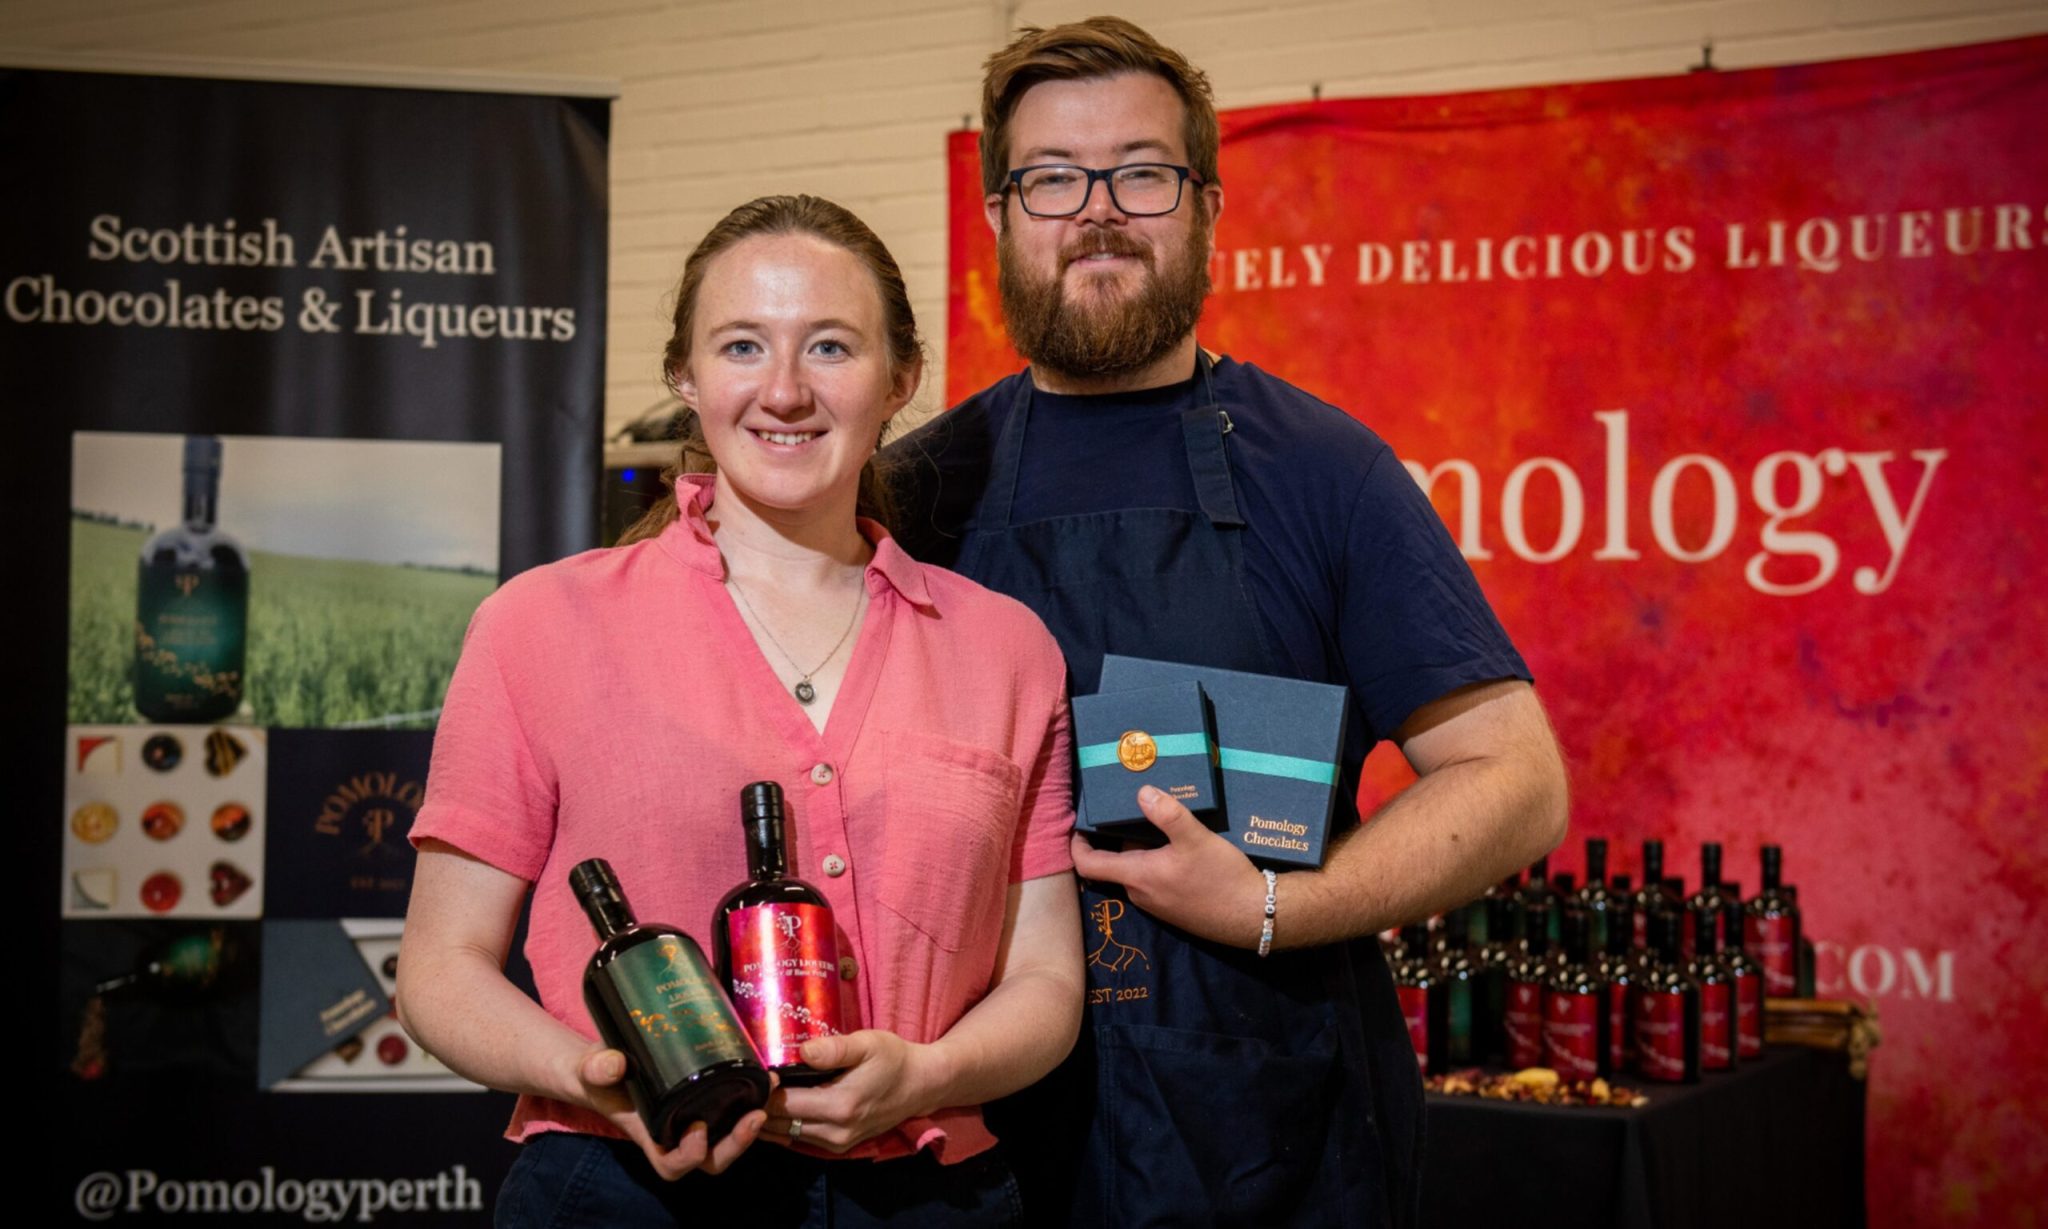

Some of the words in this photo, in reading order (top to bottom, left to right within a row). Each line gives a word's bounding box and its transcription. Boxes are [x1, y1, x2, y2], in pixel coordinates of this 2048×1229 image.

[89, 215, 296, 267] Scottish
[309, 226, 496, 275] Artisan
[1357, 226, 1696, 284] DELICIOUS
[4, 276, 285, 331] Chocolates
[298, 287, 341, 334] &
[355, 290, 576, 347] Liqueurs
[315, 772, 424, 835] POMOLO
[1250, 815, 1308, 836] Pomology
[1244, 831, 1309, 852] Chocolates
[1116, 987, 1149, 1001] 2022
[75, 1166, 483, 1222] @Pomologyperth
